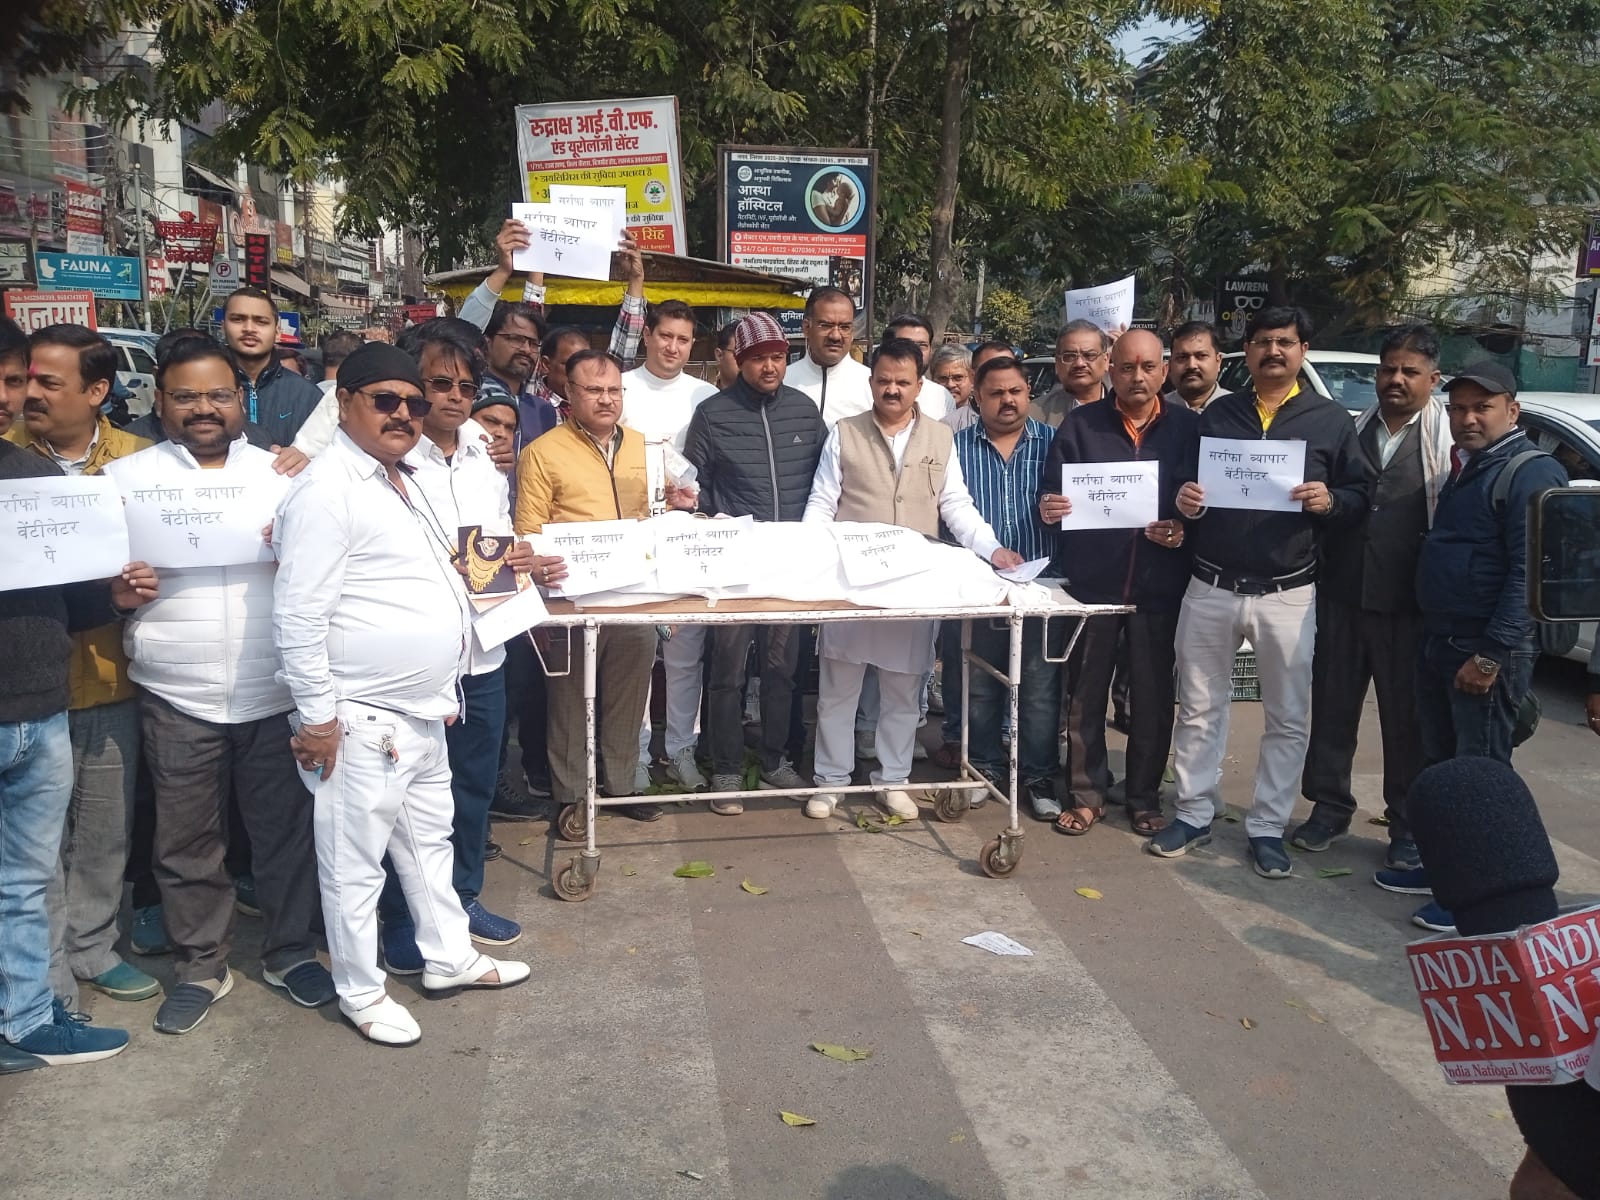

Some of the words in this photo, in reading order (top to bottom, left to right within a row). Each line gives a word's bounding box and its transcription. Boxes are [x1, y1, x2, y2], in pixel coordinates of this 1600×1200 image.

[529, 114, 573, 137] रुद्राक्ष
[577, 107, 658, 138] आई.वी.एफ.
[551, 138, 566, 155] एंड
[568, 134, 612, 158] यूरोलॉजी
[614, 133, 639, 150] सेंटर
[592, 169, 617, 182] सुविधा
[738, 185, 772, 196] आस्था
[738, 197, 783, 212] हॉस्पिटल
[642, 226, 665, 241] सिंह
[61, 259, 111, 273] FAUNA
[249, 236, 265, 283] HOTEL
[1250, 454, 1288, 464] व्यापार
[1110, 474, 1144, 485] व्यापार
[1224, 466, 1269, 480] वेंटीलेटर
[194, 486, 246, 500] व्यापार
[1088, 489, 1128, 502] वेंटीलेटर
[1241, 484, 1250, 496] पे
[50, 493, 102, 509] व्यापार
[160, 507, 223, 526] वेंटीलेटर
[1104, 505, 1112, 517] पे
[17, 518, 80, 539] वेंटीलेटर
[705, 529, 740, 540] व्यापार
[188, 532, 200, 549] पे
[44, 545, 56, 564] पे
[1409, 944, 1521, 992] INDIA
[1424, 991, 1541, 1051] N.N.
[1444, 1064, 1471, 1078] India
[1472, 1062, 1518, 1078] National
[1519, 1061, 1552, 1076] News
